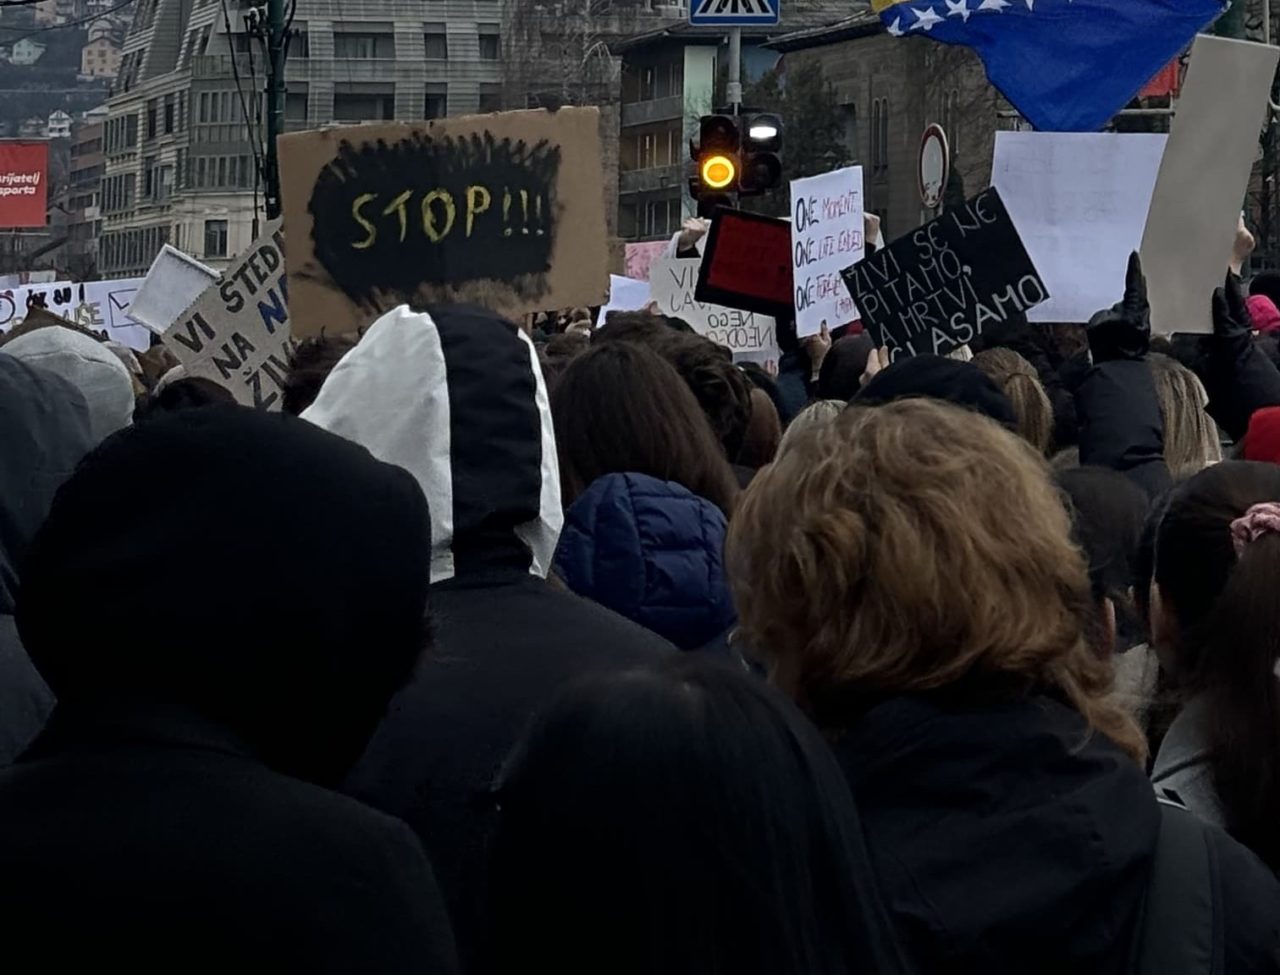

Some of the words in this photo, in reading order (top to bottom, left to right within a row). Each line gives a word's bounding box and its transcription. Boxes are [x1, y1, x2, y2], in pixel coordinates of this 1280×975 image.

[0, 170, 40, 186] rijatelj
[351, 185, 544, 249] STOP!!!
[913, 222, 949, 260] SE
[951, 192, 998, 238] NE
[794, 237, 817, 268] ONE
[795, 276, 816, 313] ONE
[879, 322, 899, 347] A
[898, 275, 979, 339] MRTVI
[172, 312, 217, 354] VI
[211, 331, 257, 381] NA
